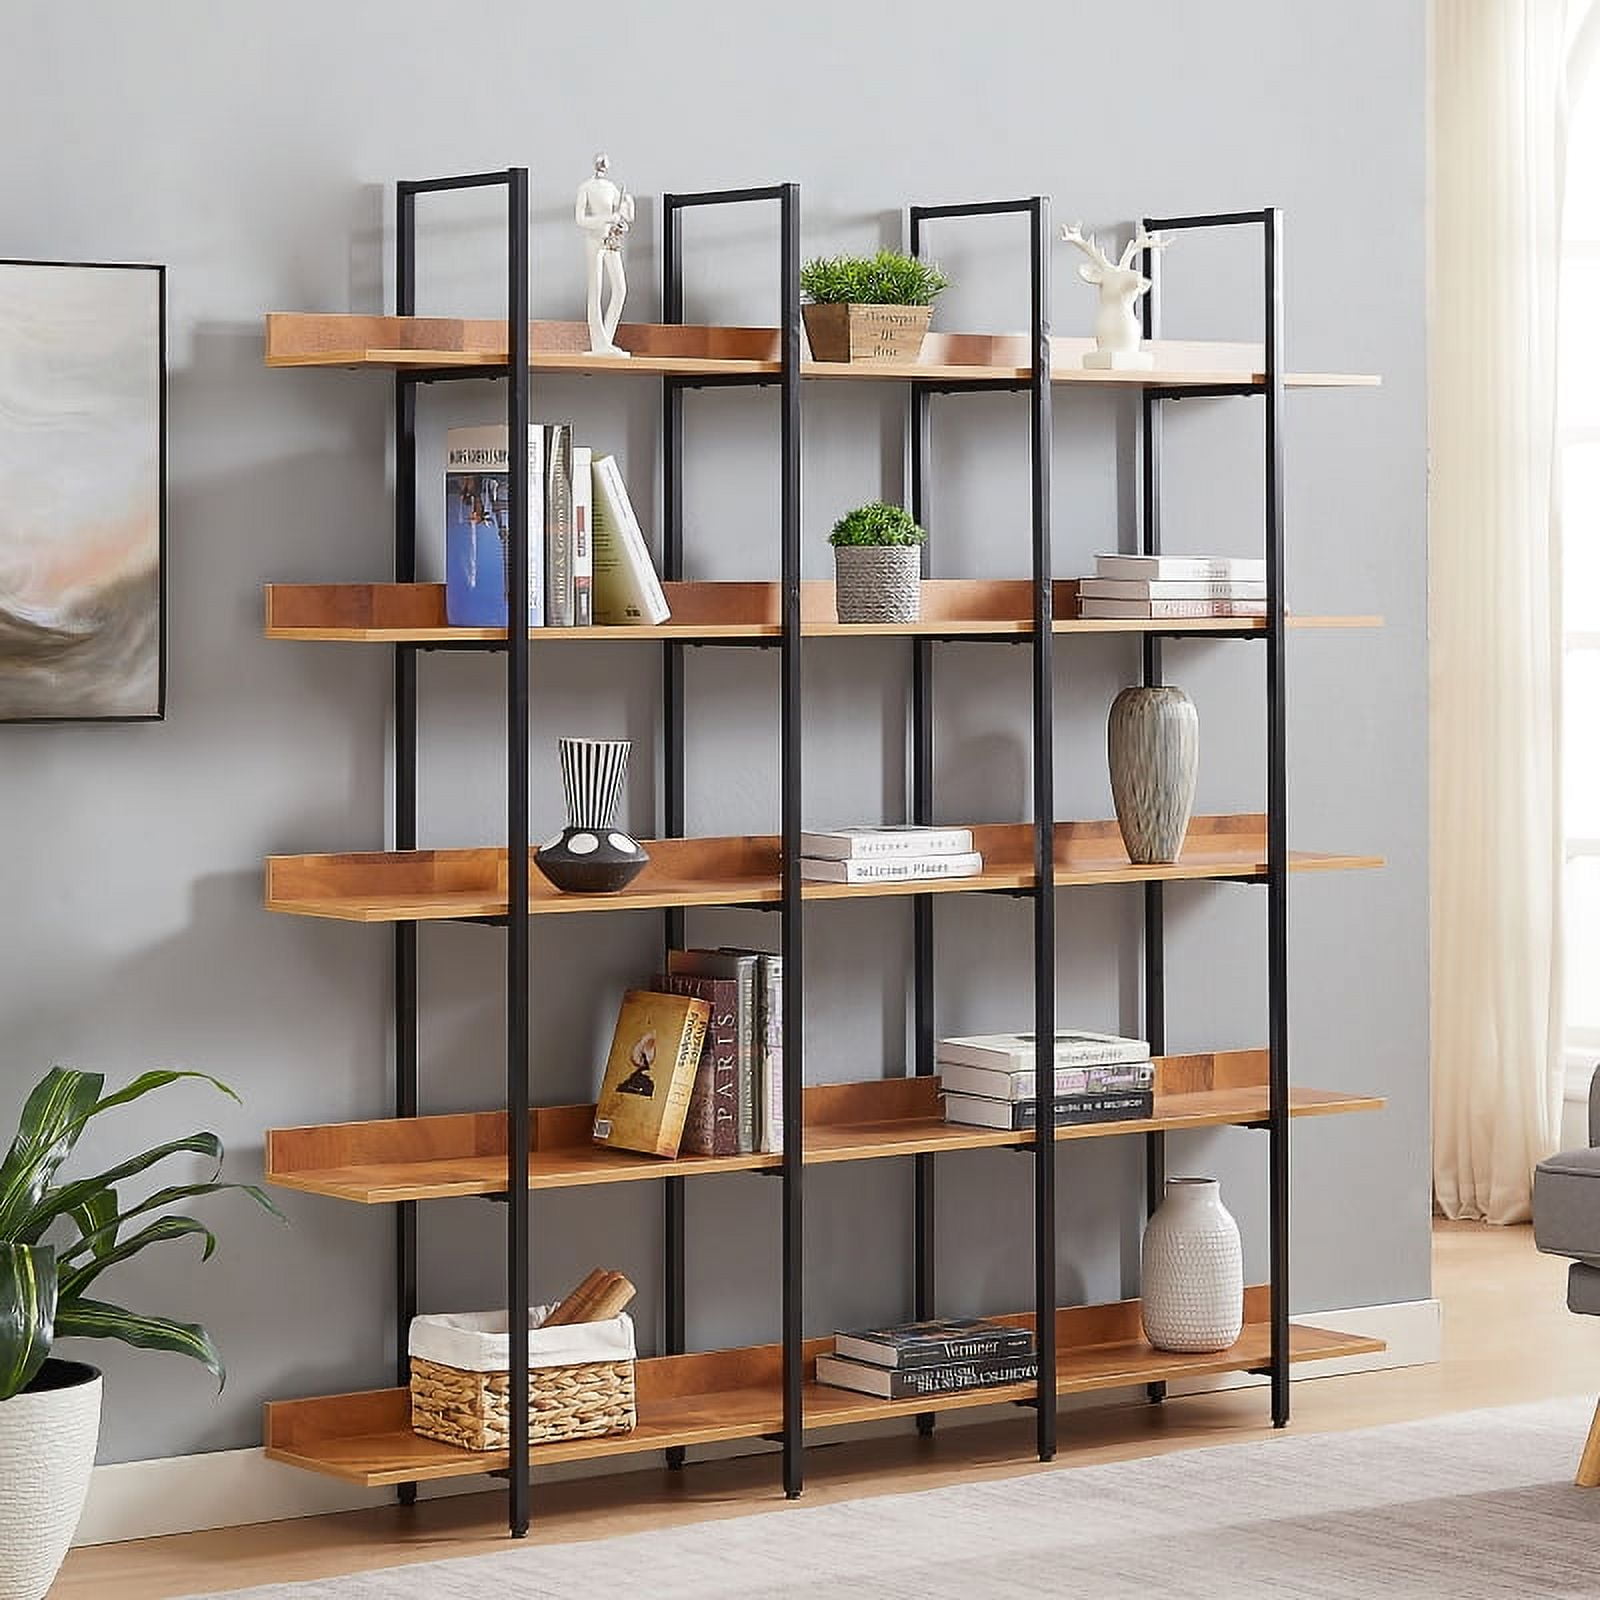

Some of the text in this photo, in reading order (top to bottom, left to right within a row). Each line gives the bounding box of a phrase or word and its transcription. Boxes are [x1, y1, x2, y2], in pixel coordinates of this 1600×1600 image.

[856, 863, 908, 877] Delicious
[717, 1013, 736, 1122] PARIS
[943, 1340, 999, 1359] Vermeer
